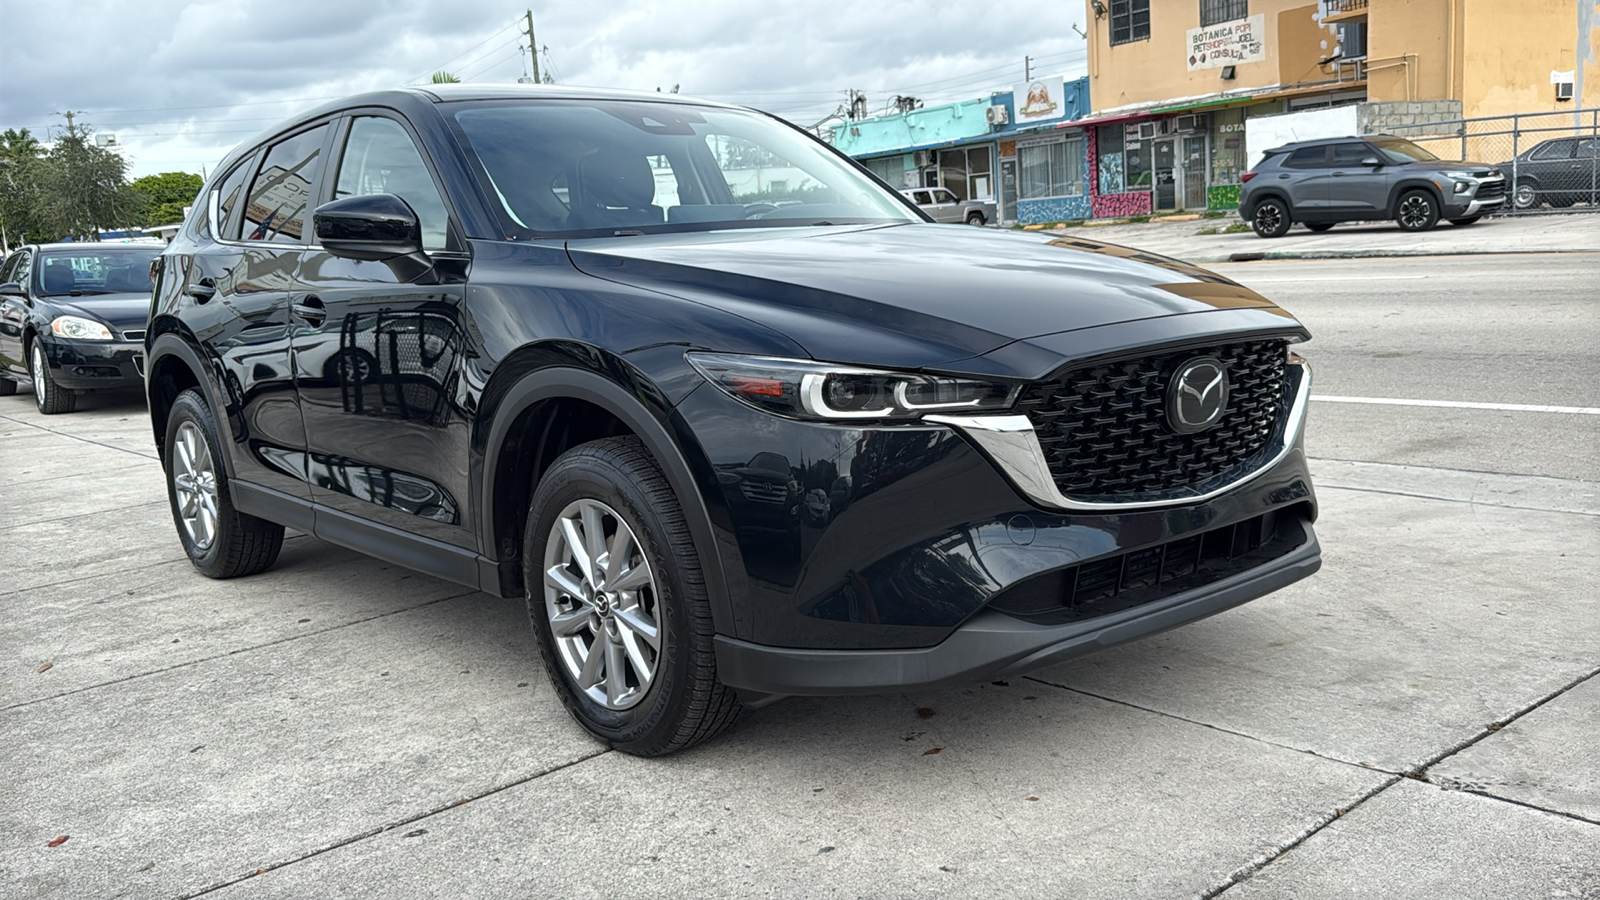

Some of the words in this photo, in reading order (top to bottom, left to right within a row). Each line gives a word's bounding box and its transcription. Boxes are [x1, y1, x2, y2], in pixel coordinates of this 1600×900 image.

[1193, 27, 1233, 43] BOTANICA
[1235, 23, 1251, 34] POPI
[1220, 123, 1245, 133] BOTA
[1126, 141, 1141, 150] Salon
